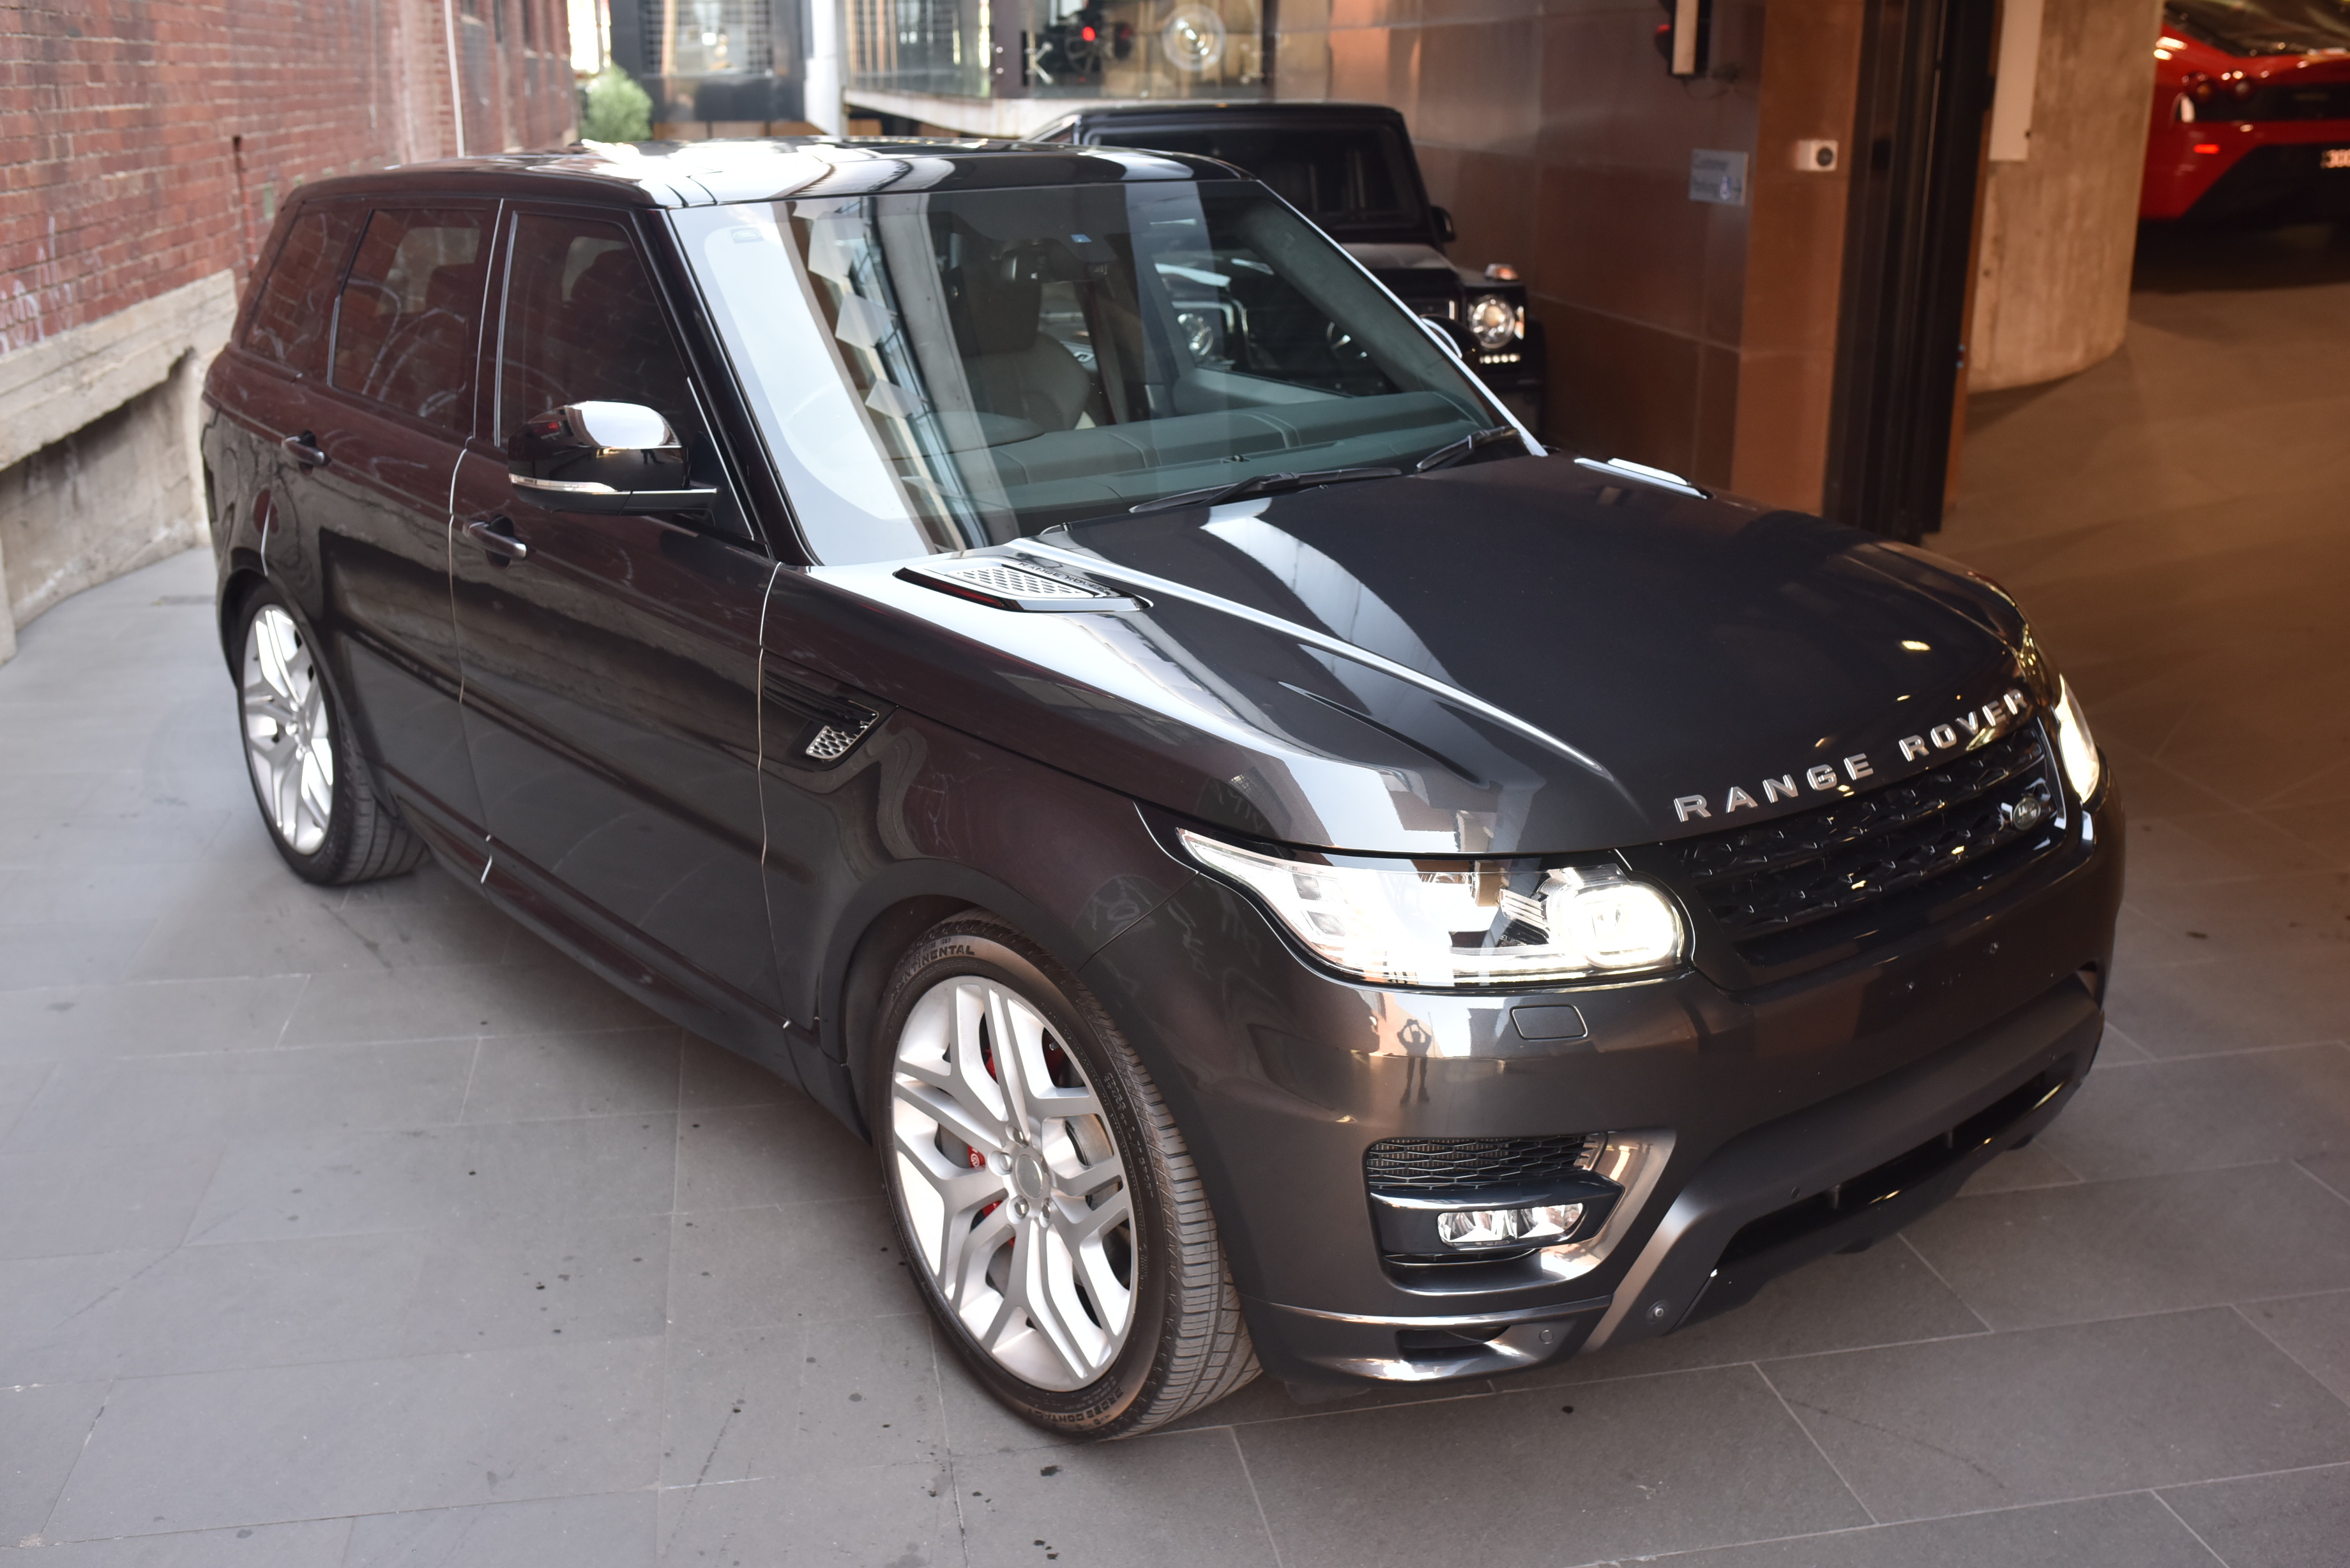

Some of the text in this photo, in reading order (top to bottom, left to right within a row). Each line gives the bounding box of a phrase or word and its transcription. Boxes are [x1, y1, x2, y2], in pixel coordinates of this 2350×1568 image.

[1019, 562, 1108, 592] RANGE ROVER
[1673, 689, 2028, 822] RANGE ROVER
